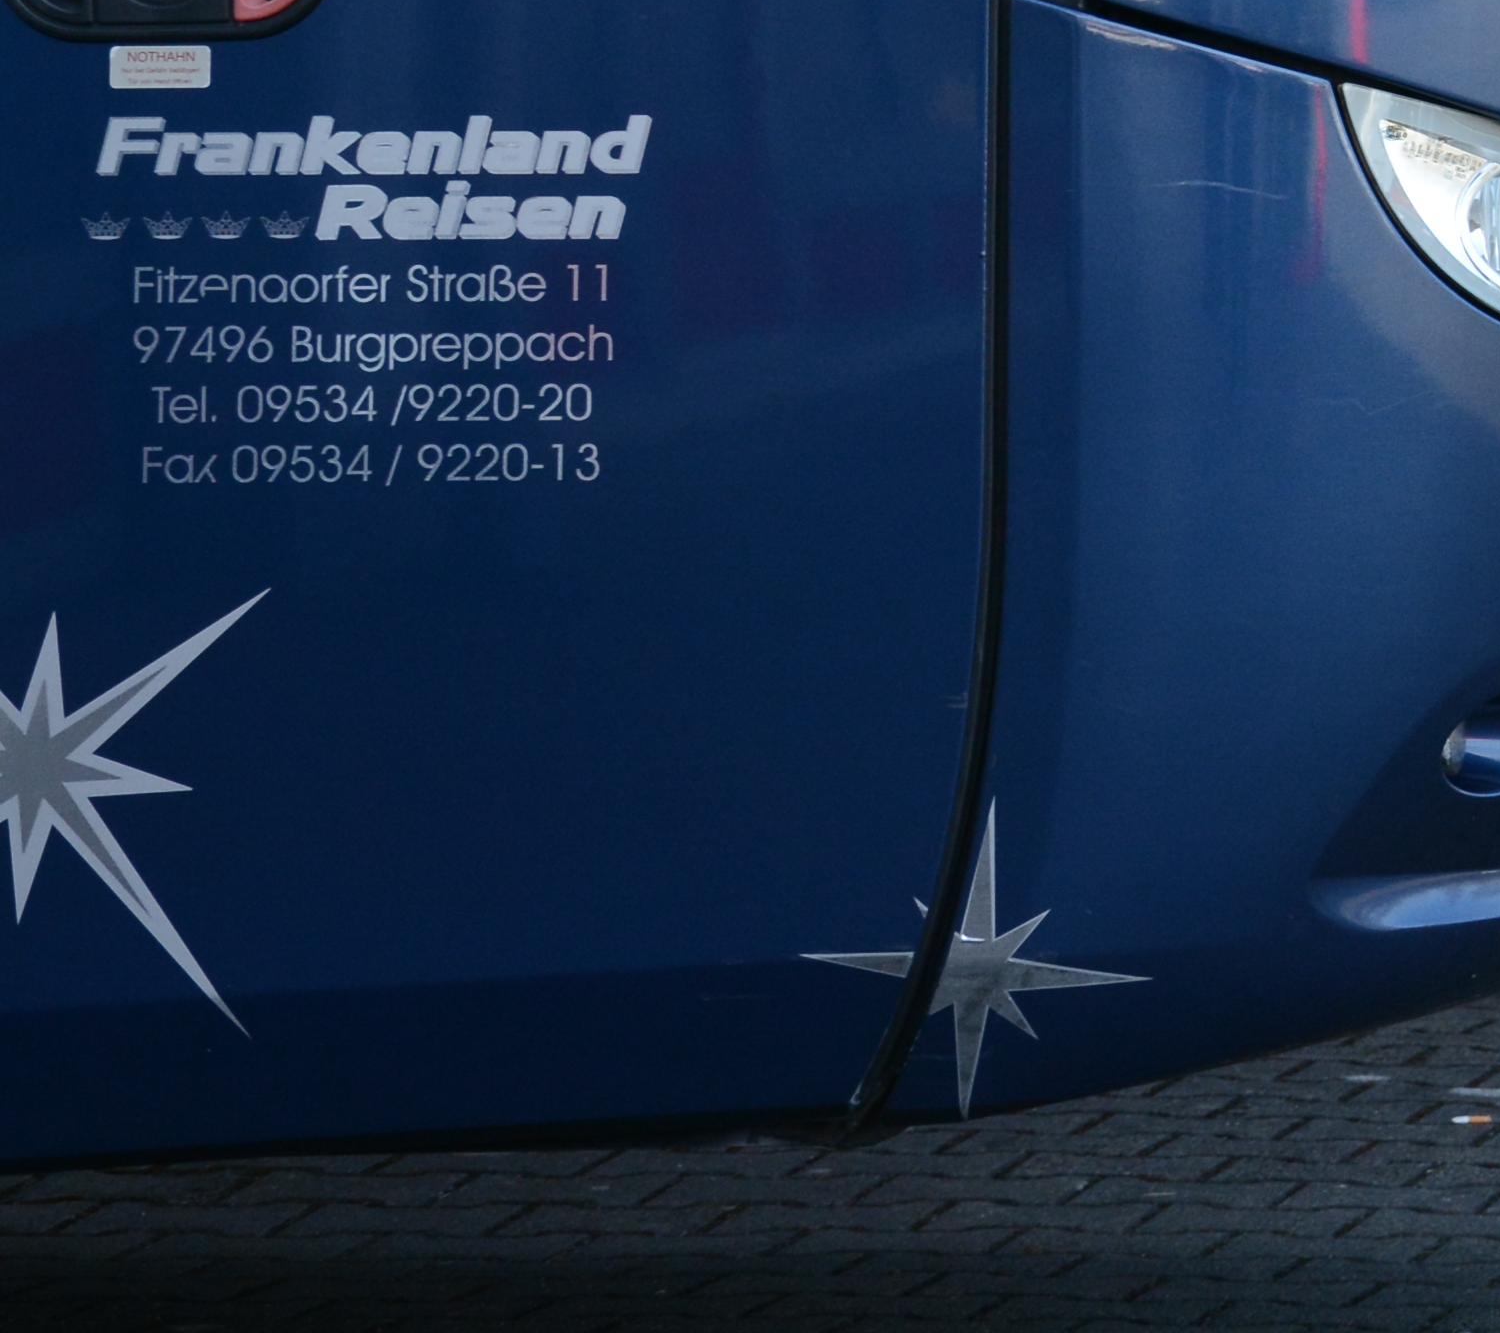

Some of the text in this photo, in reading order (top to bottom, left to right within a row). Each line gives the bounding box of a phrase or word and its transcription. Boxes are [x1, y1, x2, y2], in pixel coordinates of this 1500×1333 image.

[127, 51, 196, 62] NOTHAHN
[96, 115, 652, 176] Frankenland
[314, 181, 626, 240] Reisen
[406, 264, 547, 303] Straße
[566, 264, 608, 302] 11
[133, 324, 613, 373] 97496 Burgpreppach
[151, 386, 217, 424] Tel.
[237, 385, 377, 423] 09534
[142, 443, 601, 486] Fax 09534 / 9220-13
